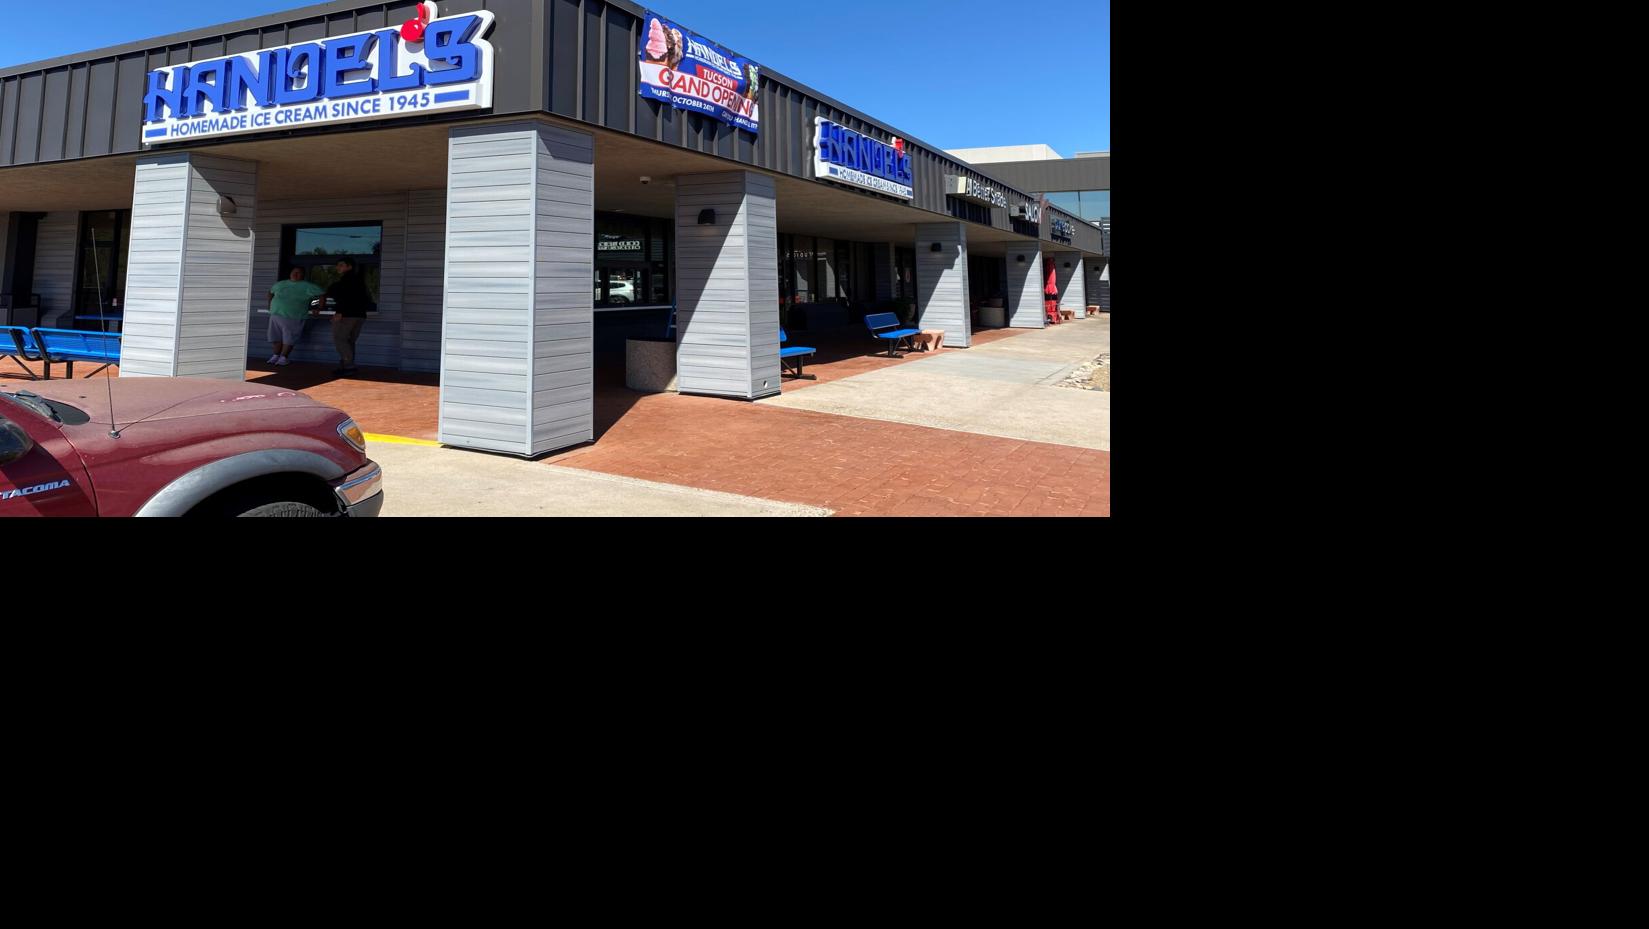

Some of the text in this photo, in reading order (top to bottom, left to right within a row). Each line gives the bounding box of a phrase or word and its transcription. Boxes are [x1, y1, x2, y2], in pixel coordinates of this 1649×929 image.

[144, 4, 483, 125] HANDEL'S
[703, 69, 733, 88] TUCSON
[658, 67, 710, 98] GAND
[170, 92, 430, 137] HOMEMADE ICE CREAM SINCE 1945
[672, 95, 703, 108] OCTOBER
[820, 121, 913, 187] HANDEL'S
[0, 479, 70, 499] TACOMA
